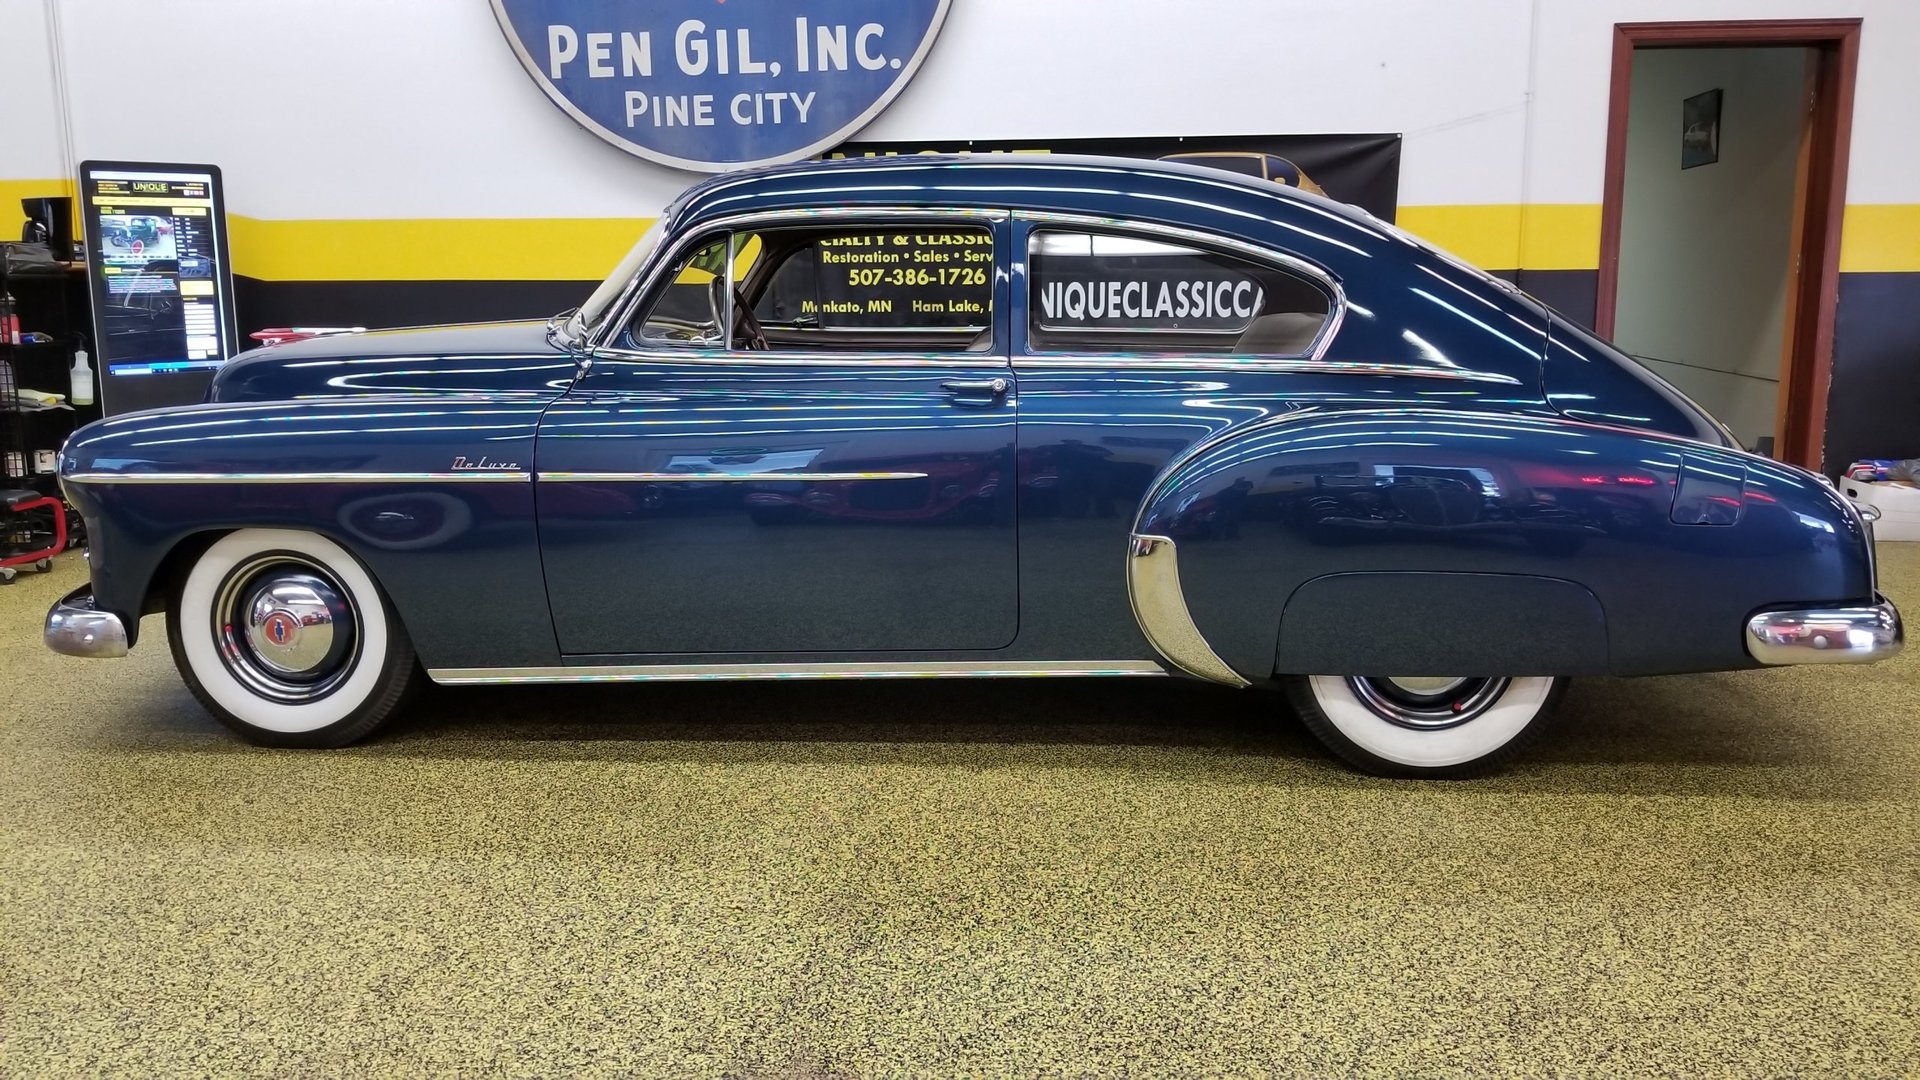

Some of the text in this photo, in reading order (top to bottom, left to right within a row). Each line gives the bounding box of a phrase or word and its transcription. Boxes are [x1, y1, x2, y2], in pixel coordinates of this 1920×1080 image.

[547, 16, 902, 80] PEN GIL, INC.
[624, 90, 816, 128] PINE CITY
[132, 181, 168, 192] UNIQUE
[892, 235, 909, 246] &
[822, 249, 993, 263] Restoration Sales Serv
[848, 267, 986, 286] 507-386-1726
[867, 299, 892, 313] MN
[911, 299, 944, 313] Ham
[948, 299, 984, 314] Lake,
[451, 456, 521, 470] DeLuxe
